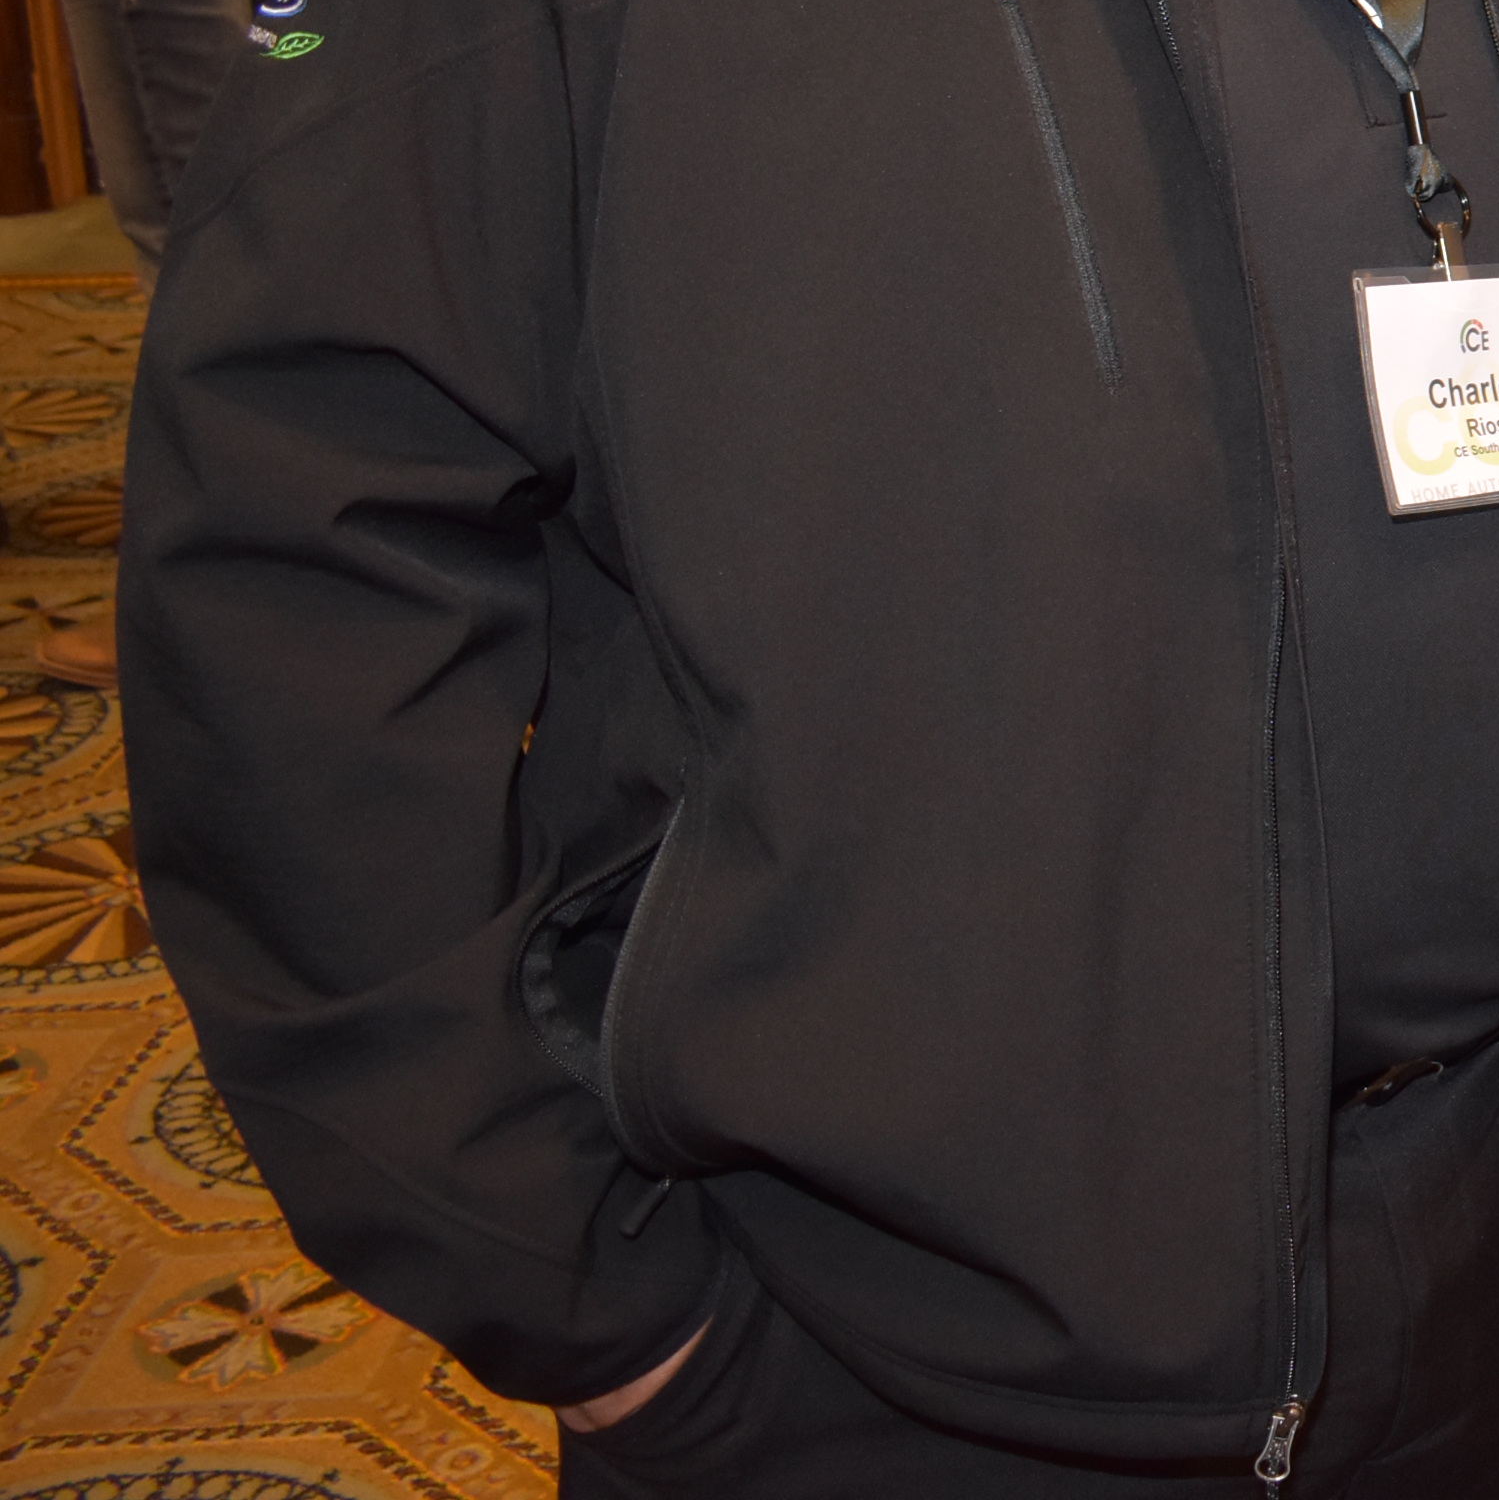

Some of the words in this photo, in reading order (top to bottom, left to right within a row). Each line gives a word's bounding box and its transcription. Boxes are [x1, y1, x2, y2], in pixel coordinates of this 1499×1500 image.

[1453, 446, 1470, 458] CE
[1470, 443, 1499, 457] South
[1411, 482, 1461, 504] HOME
